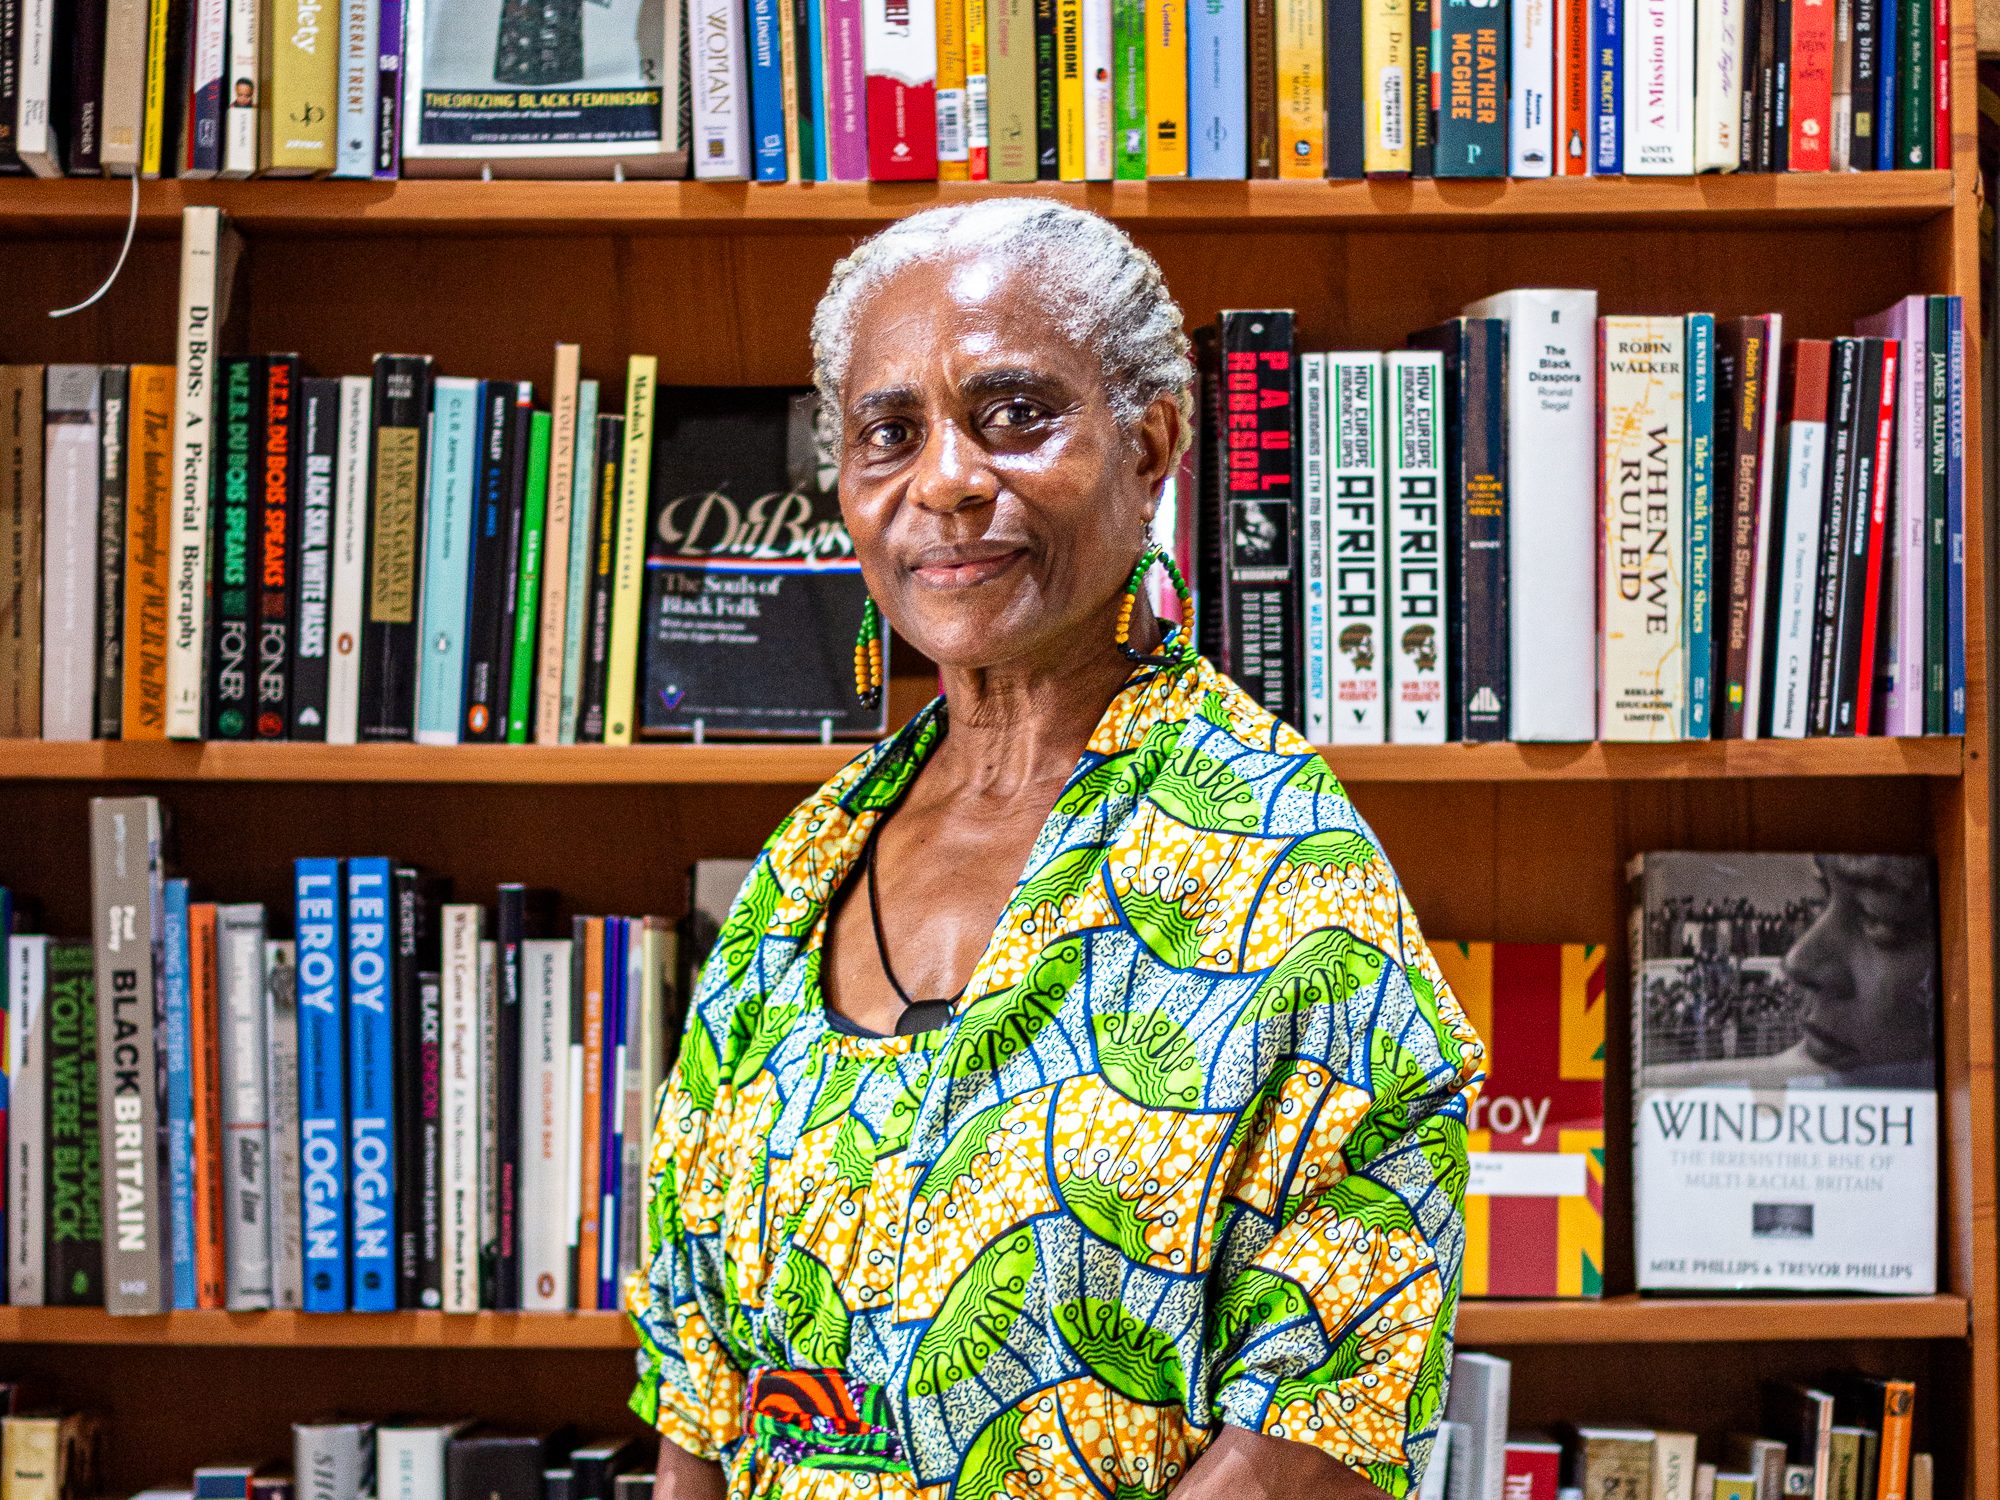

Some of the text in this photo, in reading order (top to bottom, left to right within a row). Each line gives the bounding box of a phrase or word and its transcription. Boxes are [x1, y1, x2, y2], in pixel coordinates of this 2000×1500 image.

[706, 7, 731, 115] WOMAN
[1063, 10, 1077, 80] SYNDROME
[1162, 3, 1176, 48] Goddess
[1858, 38, 1873, 79] black
[348, 66, 365, 115] TRENT
[425, 90, 658, 109] THEORIZING BLACK FEMINISMS
[1415, 46, 1427, 147] LEON MARSHALL
[1450, 33, 1472, 120] MCGHEE
[1475, 28, 1497, 124] HEATHER
[1572, 72, 1580, 111] HANDS
[1648, 36, 1664, 106] Mission
[81, 101, 94, 154] TASCHEN
[1640, 155, 1674, 163] BOOKS
[1641, 145, 1672, 154] UNITY
[1649, 114, 1665, 128] A
[1529, 371, 1581, 386] Diaspora
[1539, 357, 1571, 370] Black
[1545, 345, 1567, 357] The
[1609, 360, 1679, 375] WALKER
[1618, 343, 1671, 355] ROBIN
[1742, 337, 1761, 432] Robin Walker
[1839, 341, 1856, 422] Carter Woodson
[1229, 351, 1259, 492] ROBESON
[1342, 366, 1353, 469] UNDERDEVELOPED
[1355, 366, 1369, 469] HOW EUROPE
[1404, 366, 1416, 469] UNDERDEVELOPED
[1417, 366, 1431, 469] HOW EUROPE
[1538, 386, 1573, 398] Ronald
[1541, 400, 1570, 413] Segal
[1879, 419, 1890, 439] THE
[1913, 340, 1926, 449] DUKE ELLINGTON
[1931, 351, 1946, 475] JAMES BALDWIN
[1951, 331, 1962, 459] FREDERICK DOUGLASS
[103, 399, 122, 480] Douglass
[554, 394, 573, 524] STOLEN LEGACY
[1308, 360, 1321, 579] THE GROUNDINGS WITH MY BROTHERS
[136, 408, 167, 567] The Autobiography
[225, 422, 248, 584] DU BOIS SPEAKS
[262, 424, 288, 587] DU BOIS SPEAKS
[377, 447, 396, 605] LIFE AND LESSONS
[389, 432, 416, 617] MARCUS GARVEY
[599, 462, 616, 576] REVOLUTIONARY NOTES
[1469, 507, 1501, 516] AFRICA
[1852, 457, 1870, 556] BLACK CIVILIZATION
[177, 410, 204, 652] A Pictorial Biography
[299, 455, 330, 657] BLACK SKIN, WHITE MASKS
[1337, 476, 1375, 618] AFRICA
[1400, 476, 1437, 619] AFRICA
[1619, 458, 1642, 602] RULED
[1646, 424, 1668, 636] WHEN WE
[1691, 434, 1706, 634] Take a Walk in Their Shoes
[1730, 453, 1756, 650] Before the Slave Trade
[660, 596, 760, 617] Black Folk
[664, 574, 784, 596] The Souls of
[1824, 538, 1841, 618] OF NEGRO
[218, 621, 245, 701] FONER
[258, 623, 285, 703] FONER
[1241, 591, 1260, 676] DUBERMAN
[1263, 591, 1282, 651] MARTIN
[1311, 604, 1322, 699] WALTER RODNEY
[1616, 700, 1673, 710] EDUCATION
[1623, 713, 1664, 722] LIMITED
[1782, 680, 1798, 731] Publishing
[123, 905, 138, 941] Paul
[400, 890, 415, 955] SECRETS
[52, 977, 81, 1045] YOU
[166, 913, 184, 1072] LOVING THE SISTERS
[230, 934, 260, 1121] Marriage across the
[452, 912, 467, 1079] When Came England
[52, 1053, 82, 1137] WERE
[299, 873, 338, 1259] LEROY LOGAN
[349, 873, 388, 1258] LEROY LOGAN
[543, 953, 554, 1159] SUSAN WILLIAMS COLOUR BAR
[171, 1118, 187, 1180] PAMELA
[1650, 1100, 1915, 1147] WINDRUSH
[1671, 1149, 1895, 1170] THE IRRESISTIBLE RISE OF
[52, 1145, 82, 1242] BLACK
[238, 1137, 263, 1224] Color Line
[1815, 1175, 1885, 1192] BRITAIN
[1649, 1259, 1914, 1280] MIKE PHILLIPS TREVOR PHILLIPS
